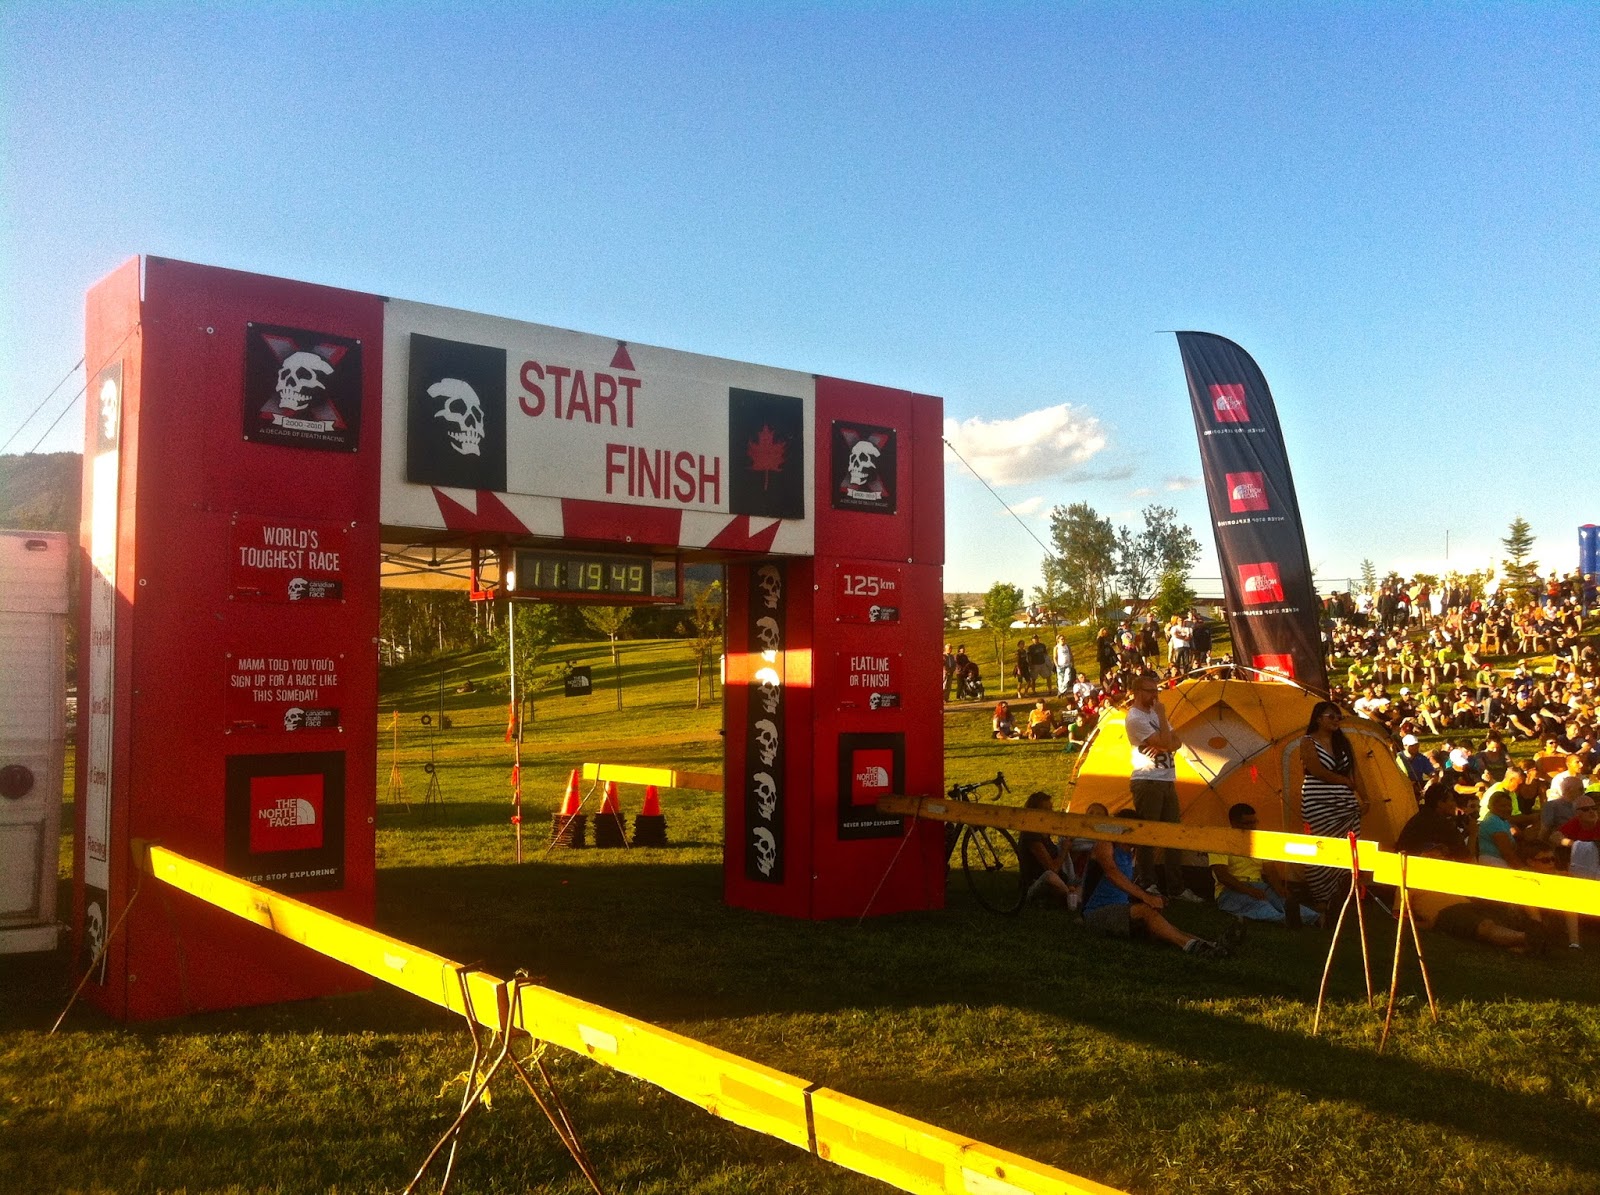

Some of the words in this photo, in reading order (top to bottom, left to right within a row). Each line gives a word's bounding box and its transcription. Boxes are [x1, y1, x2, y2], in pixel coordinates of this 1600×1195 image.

[518, 360, 642, 428] START
[266, 428, 291, 437] DECADE
[301, 431, 322, 440] DEATH
[322, 433, 345, 442] RACING
[605, 443, 720, 505] FINISH
[263, 526, 319, 549] WORLD'S
[239, 546, 304, 569] TOUGHEST
[308, 551, 340, 571] RACE
[238, 658, 265, 670] MAMA
[268, 659, 289, 671] TOLD
[292, 659, 309, 670] YOU
[311, 657, 334, 671] YOU'D
[851, 656, 890, 672] FLATLINE
[231, 674, 251, 687] SIGN
[254, 674, 266, 686] UP
[269, 674, 285, 687] FOR
[287, 674, 293, 686] A
[296, 674, 317, 686] RACE
[320, 674, 338, 687] LIKE
[850, 674, 859, 687] OR
[862, 673, 890, 688] FINISH
[252, 689, 273, 702] THIS
[276, 689, 318, 702] SOMEDAY!
[305, 719, 322, 727] race
[856, 773, 878, 781] NORTH
[866, 766, 878, 774] THE
[275, 798, 297, 809] THE
[258, 808, 297, 819] NORTH
[269, 817, 297, 828] FACE
[240, 874, 264, 882] EVER
[266, 872, 288, 881] STOP
[289, 867, 336, 879] EXPLORING
